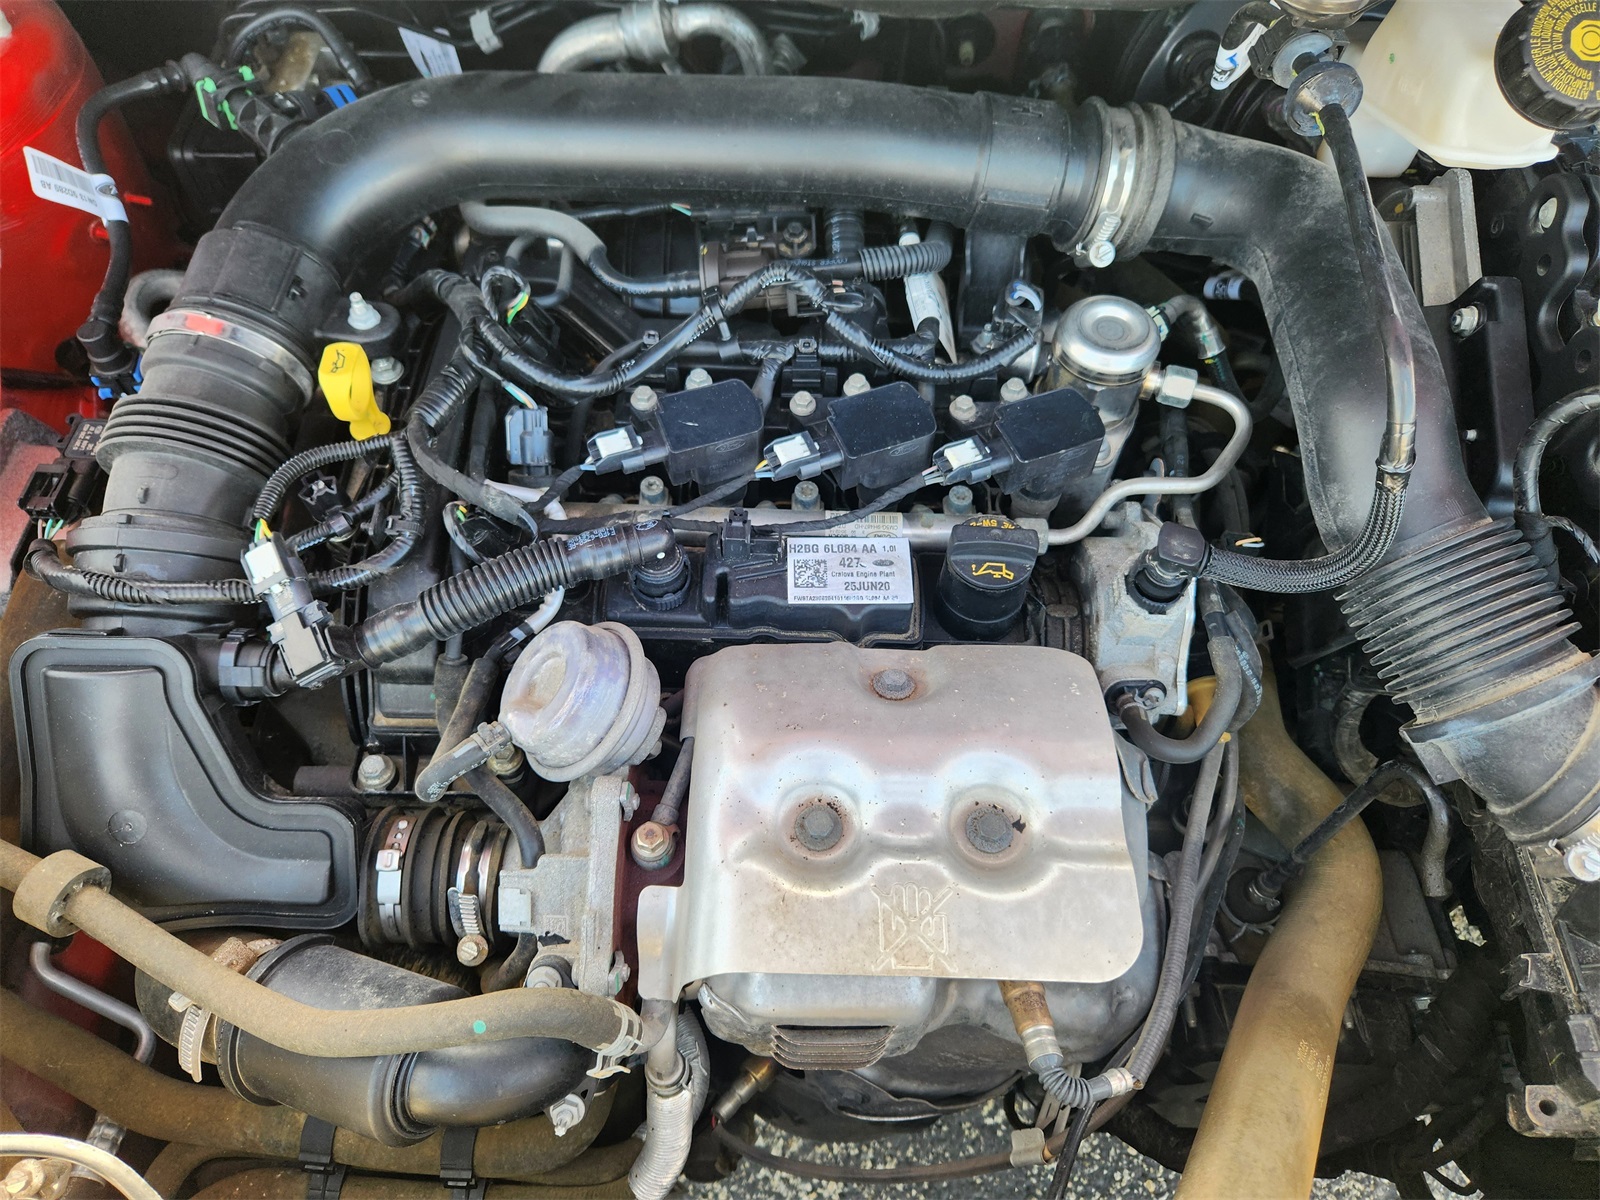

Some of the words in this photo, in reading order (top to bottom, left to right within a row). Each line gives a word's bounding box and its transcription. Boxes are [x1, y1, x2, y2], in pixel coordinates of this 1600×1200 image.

[1549, 7, 1562, 18] DE
[1570, 2, 1597, 16] SCELLE
[1531, 4, 1551, 36] BOUCHON
[1554, 11, 1573, 31] BIDON
[1541, 16, 1556, 43] LIQUIDE
[1530, 38, 1541, 48] LE
[1541, 44, 1553, 55] DU
[1552, 32, 1563, 50] D'UN
[1531, 49, 1554, 82] NETTOYER
[1543, 53, 1559, 70] QUE
[1555, 51, 1592, 79] PROVENANT
[1553, 66, 1595, 92] N'EMPLOYER
[1551, 79, 1589, 100] ATTENTION
[789, 543, 819, 554] H2BG
[823, 543, 858, 554] 6L084
[861, 543, 877, 554] AA
[838, 557, 861, 568] 427
[856, 571, 878, 579] Engine
[844, 581, 891, 591] 25JUN20
